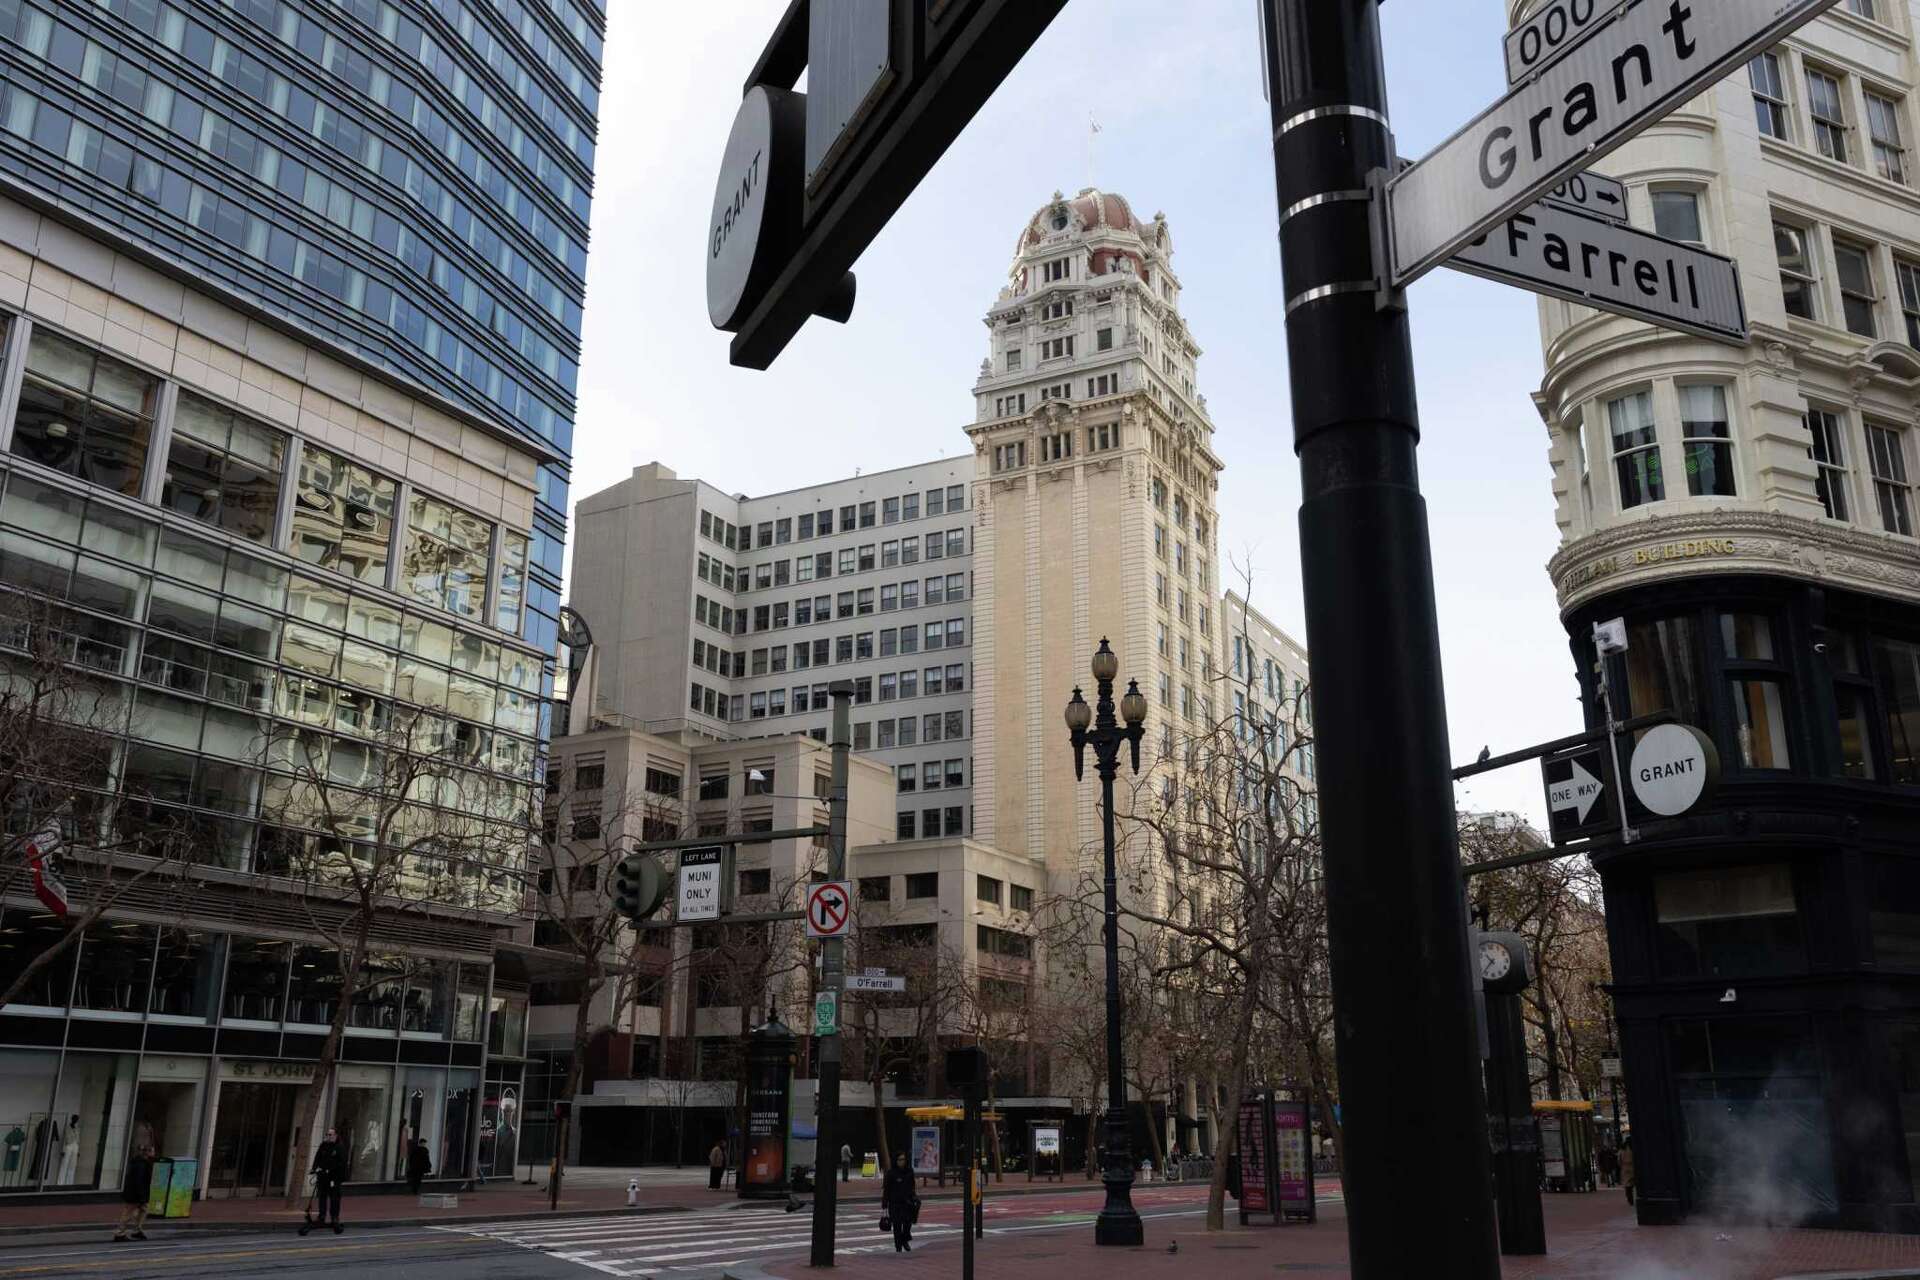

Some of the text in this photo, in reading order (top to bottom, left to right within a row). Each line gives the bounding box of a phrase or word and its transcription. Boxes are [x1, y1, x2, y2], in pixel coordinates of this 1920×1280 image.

[1478, 0, 1697, 190] Grant
[711, 149, 762, 260] GRANT
[1633, 539, 1736, 565] BUILDING
[1639, 757, 1696, 784] GRANT
[1551, 783, 1598, 803] ONE WAY
[685, 854, 699, 862] LEFT
[688, 871, 712, 882] MUNI
[686, 888, 711, 900] ONLY
[856, 977, 893, 988] O'Farrell
